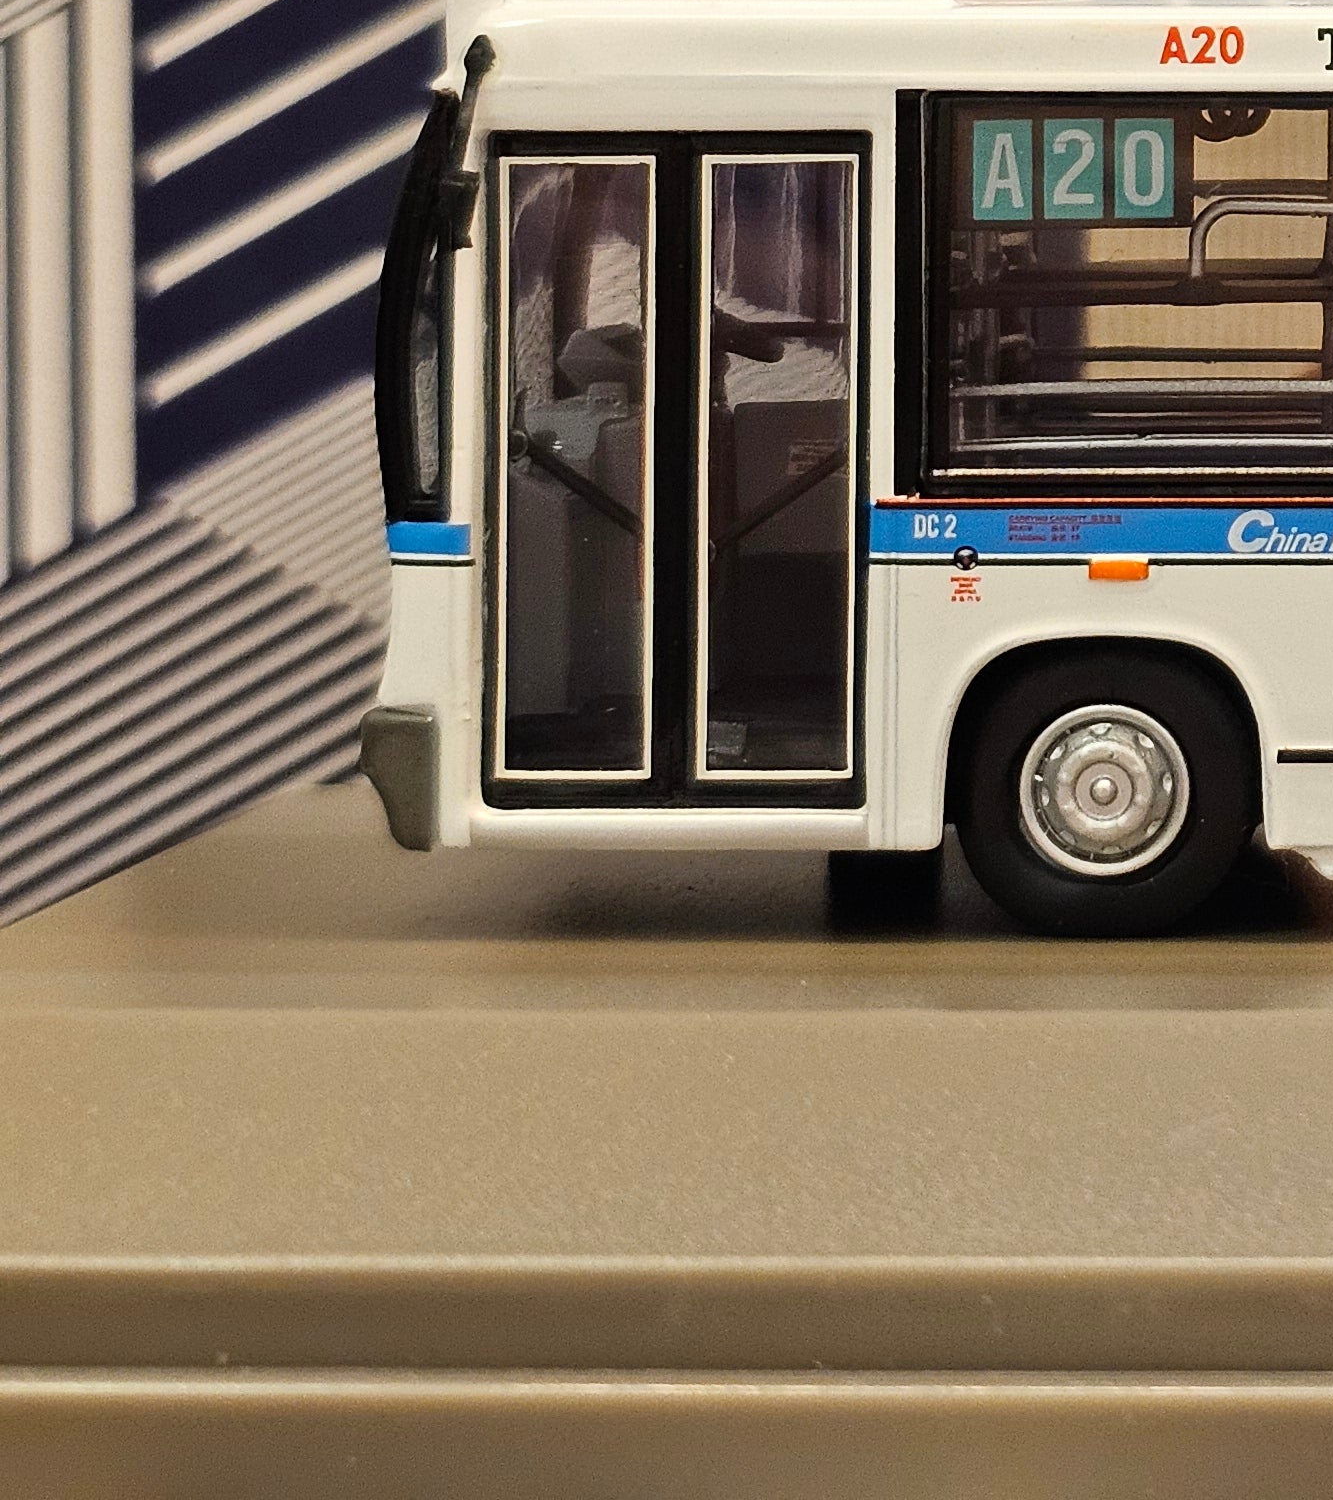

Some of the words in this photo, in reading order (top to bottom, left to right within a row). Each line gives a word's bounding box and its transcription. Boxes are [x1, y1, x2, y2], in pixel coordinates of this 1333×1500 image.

[1159, 26, 1245, 65] A20
[980, 129, 1166, 209] A20
[913, 514, 939, 539] DC
[944, 514, 957, 539] 2
[1227, 509, 1329, 553] China
